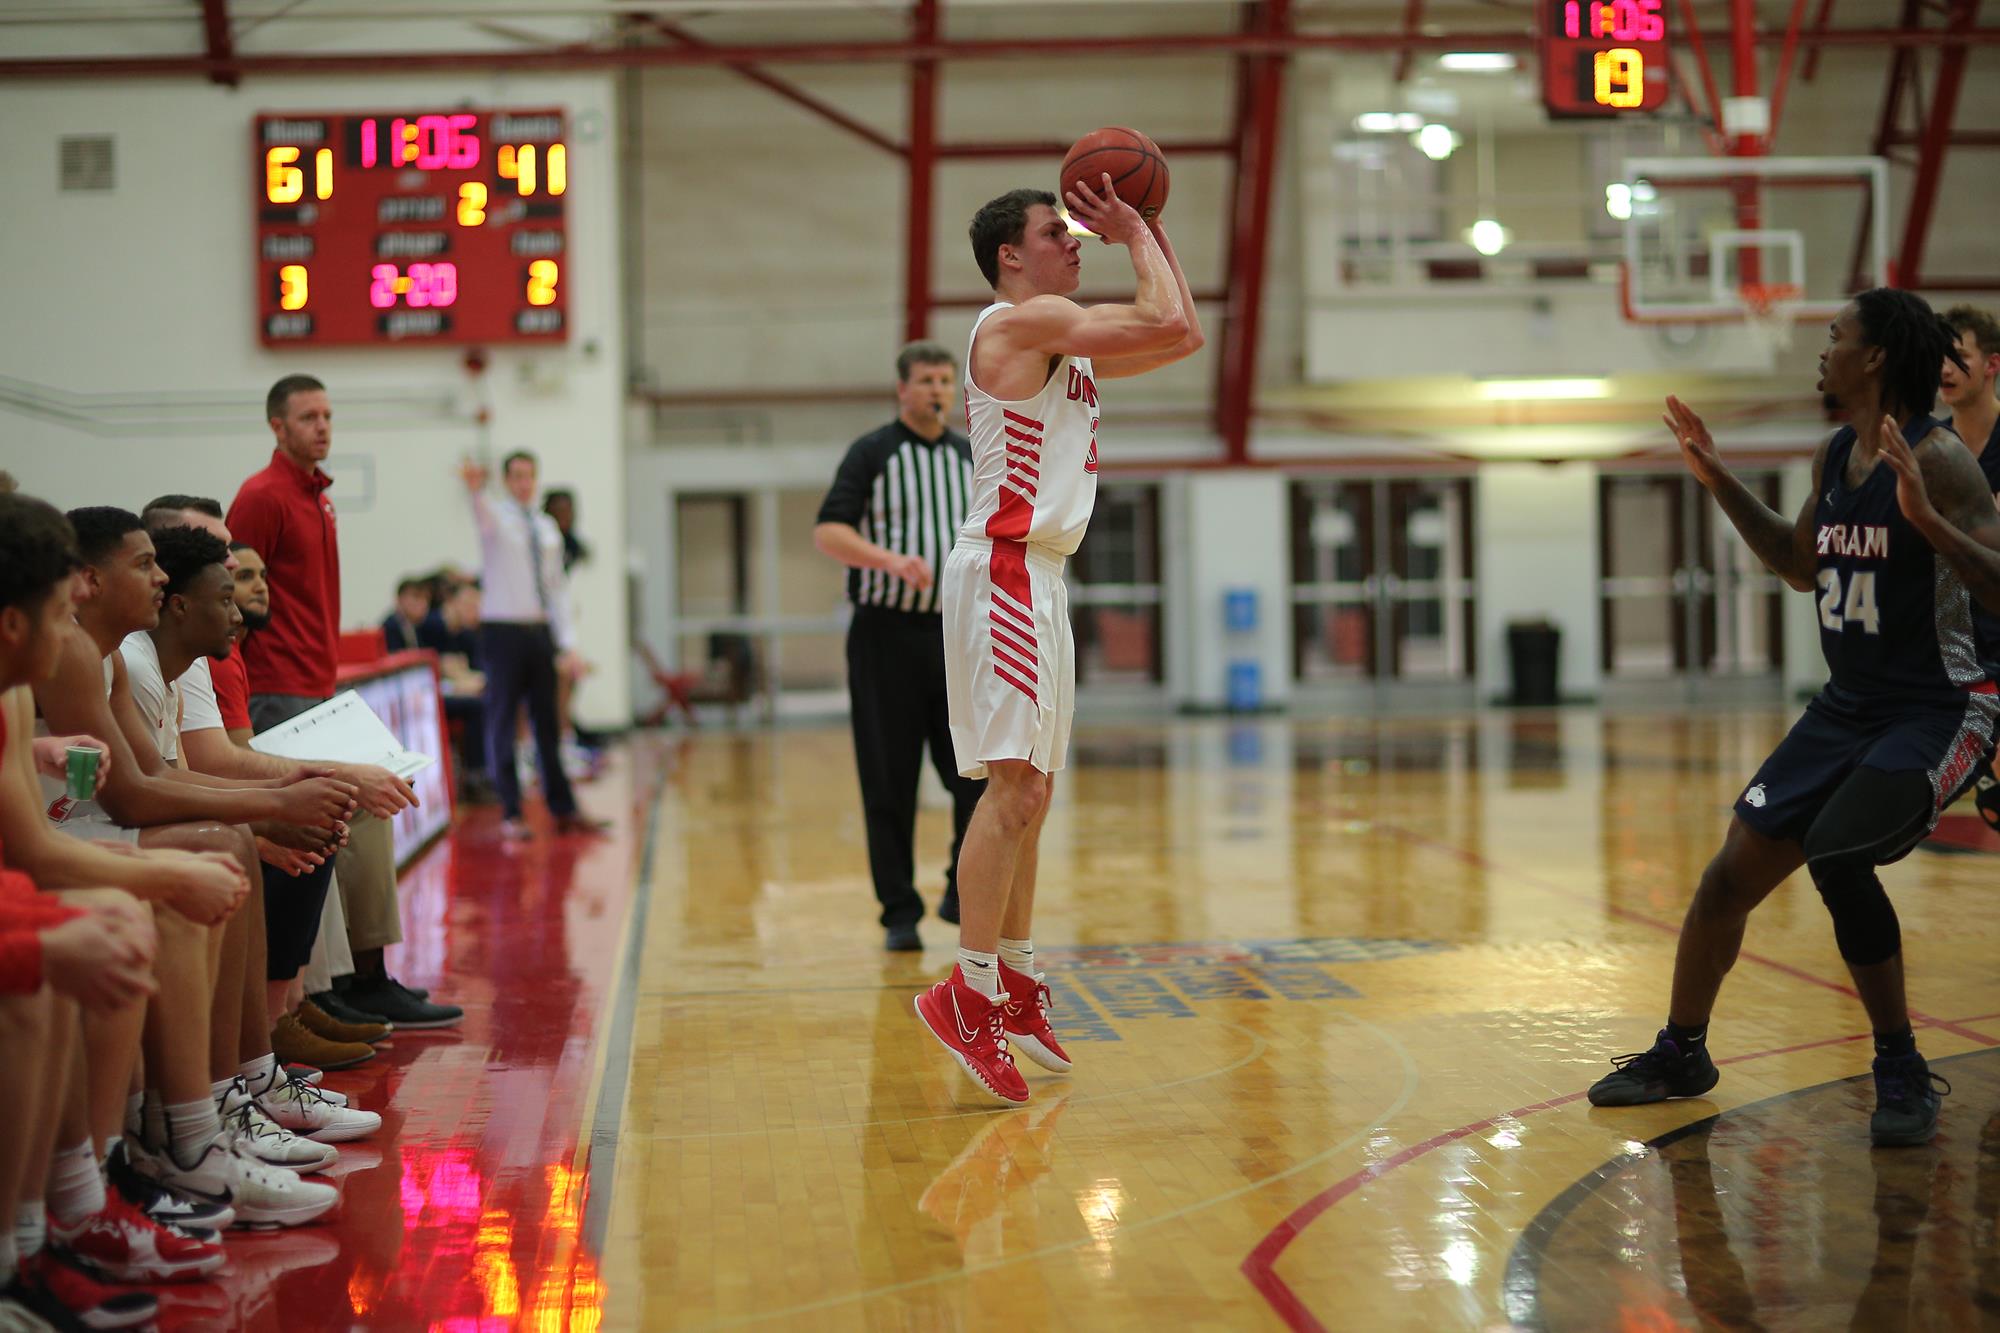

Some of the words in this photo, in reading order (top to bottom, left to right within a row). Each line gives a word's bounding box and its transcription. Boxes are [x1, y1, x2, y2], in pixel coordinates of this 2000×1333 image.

[266, 146, 334, 203] 61
[497, 143, 567, 196] 41
[457, 181, 488, 226] 2
[280, 264, 308, 310] 3
[527, 259, 559, 305] 2
[1816, 524, 1888, 558] HRAM
[1816, 566, 1880, 635] 24
